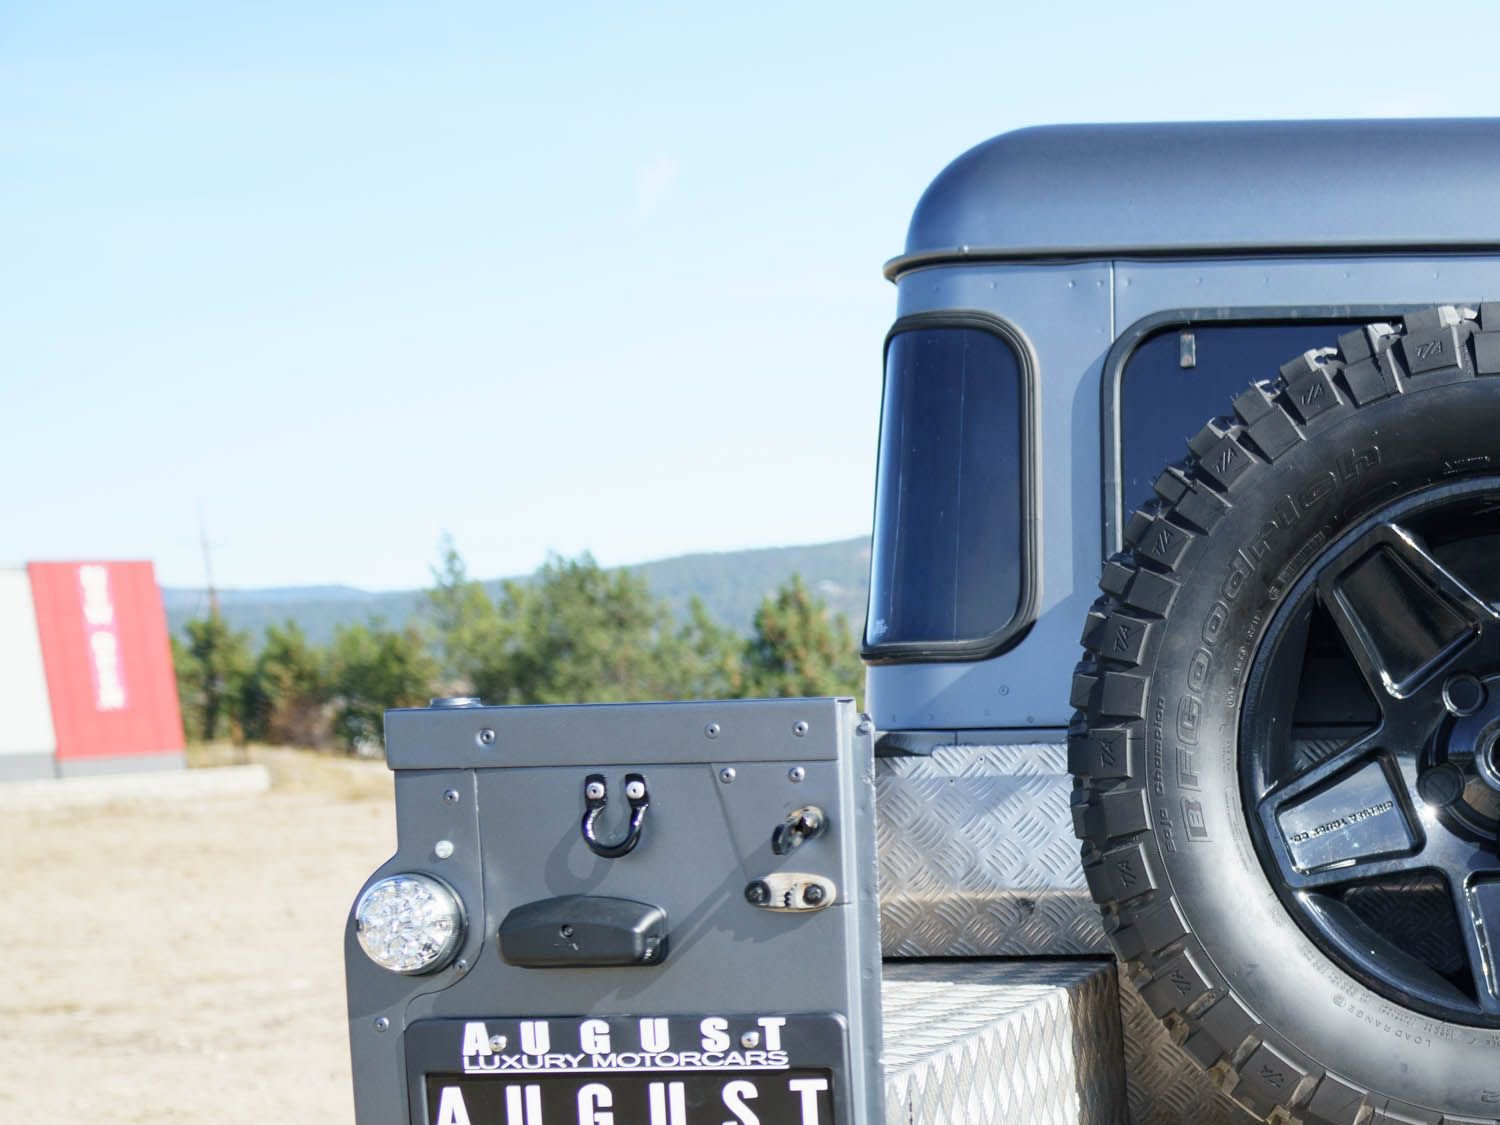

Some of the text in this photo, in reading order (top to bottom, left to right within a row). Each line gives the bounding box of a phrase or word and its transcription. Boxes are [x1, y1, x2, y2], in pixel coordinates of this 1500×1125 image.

[1176, 444, 1383, 842] BFGoodrich
[1152, 694, 1179, 854] Baja Champion
[462, 1017, 787, 1056] AUGUST
[463, 1050, 790, 1070] LUXURY MOTORCARS
